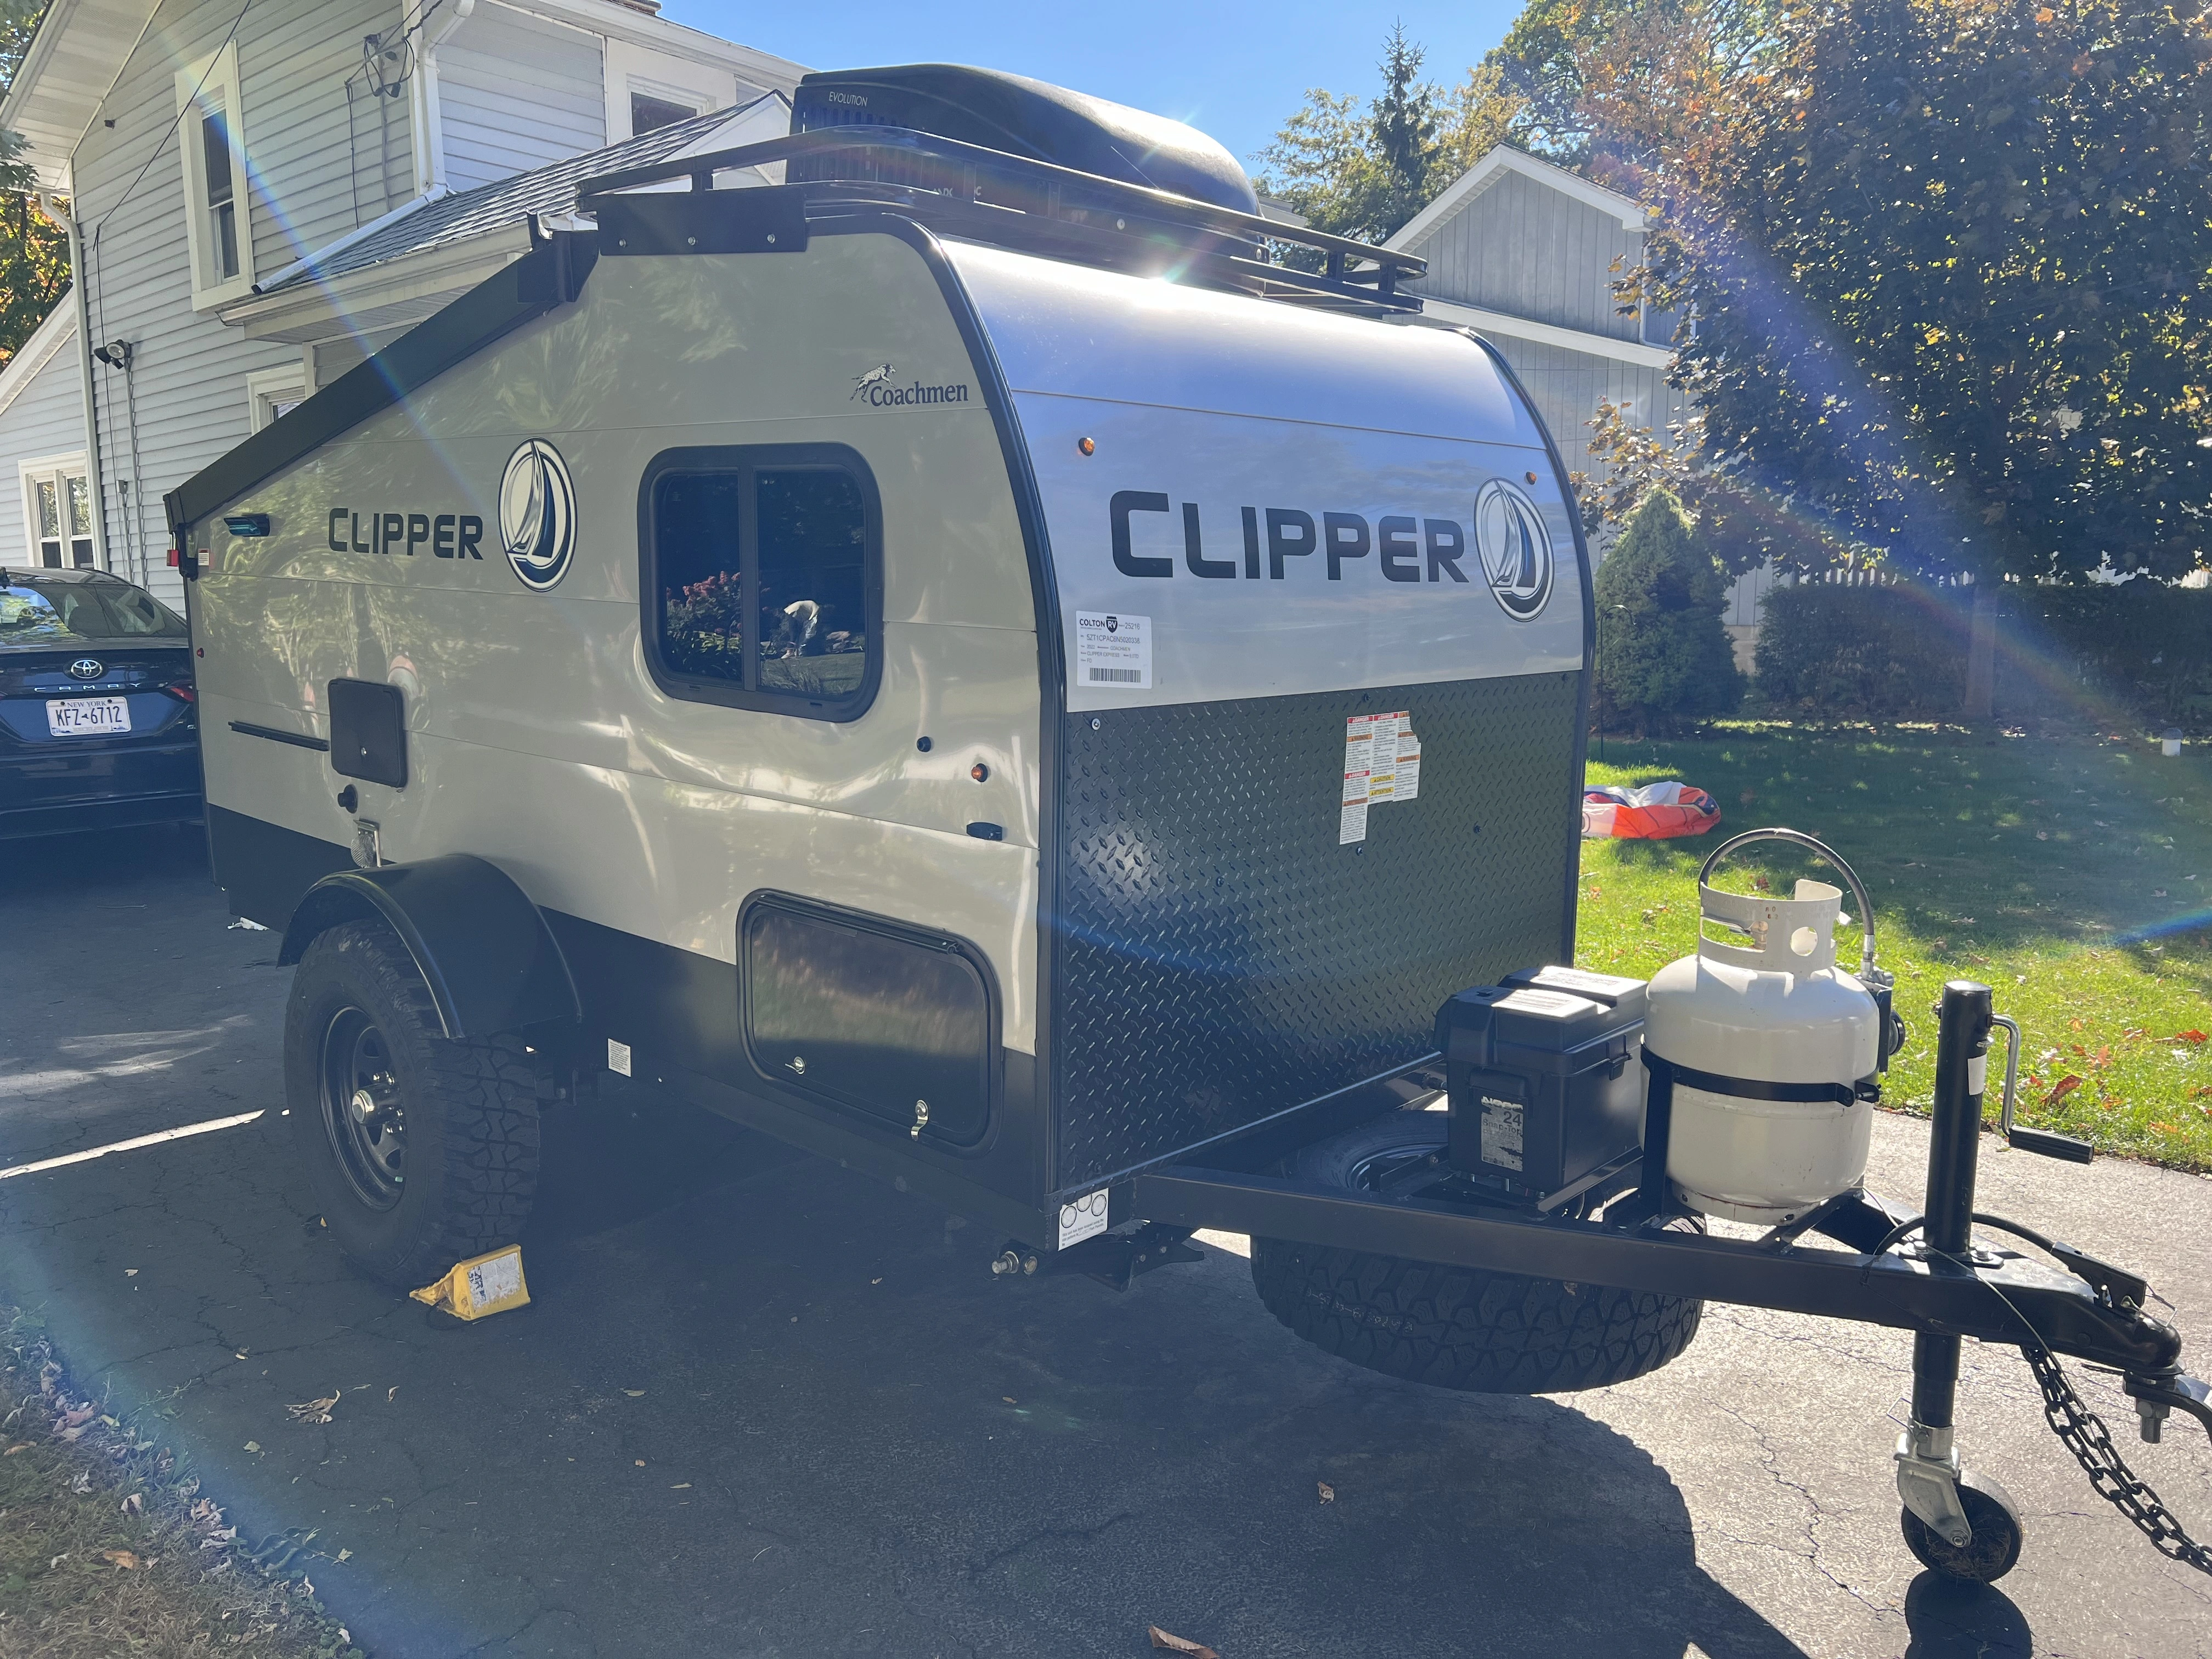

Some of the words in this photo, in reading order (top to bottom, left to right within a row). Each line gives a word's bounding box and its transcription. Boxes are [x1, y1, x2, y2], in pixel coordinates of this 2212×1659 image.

[828, 91, 868, 107] EVOLUTION
[870, 381, 968, 407] Coachmen
[329, 508, 483, 560] CLIPPER
[1110, 490, 1469, 583] CLIPPER
[1080, 619, 1105, 627] COLTON
[1483, 1118, 1522, 1136] Snap-Top
[1503, 1111, 1522, 1126] 24
